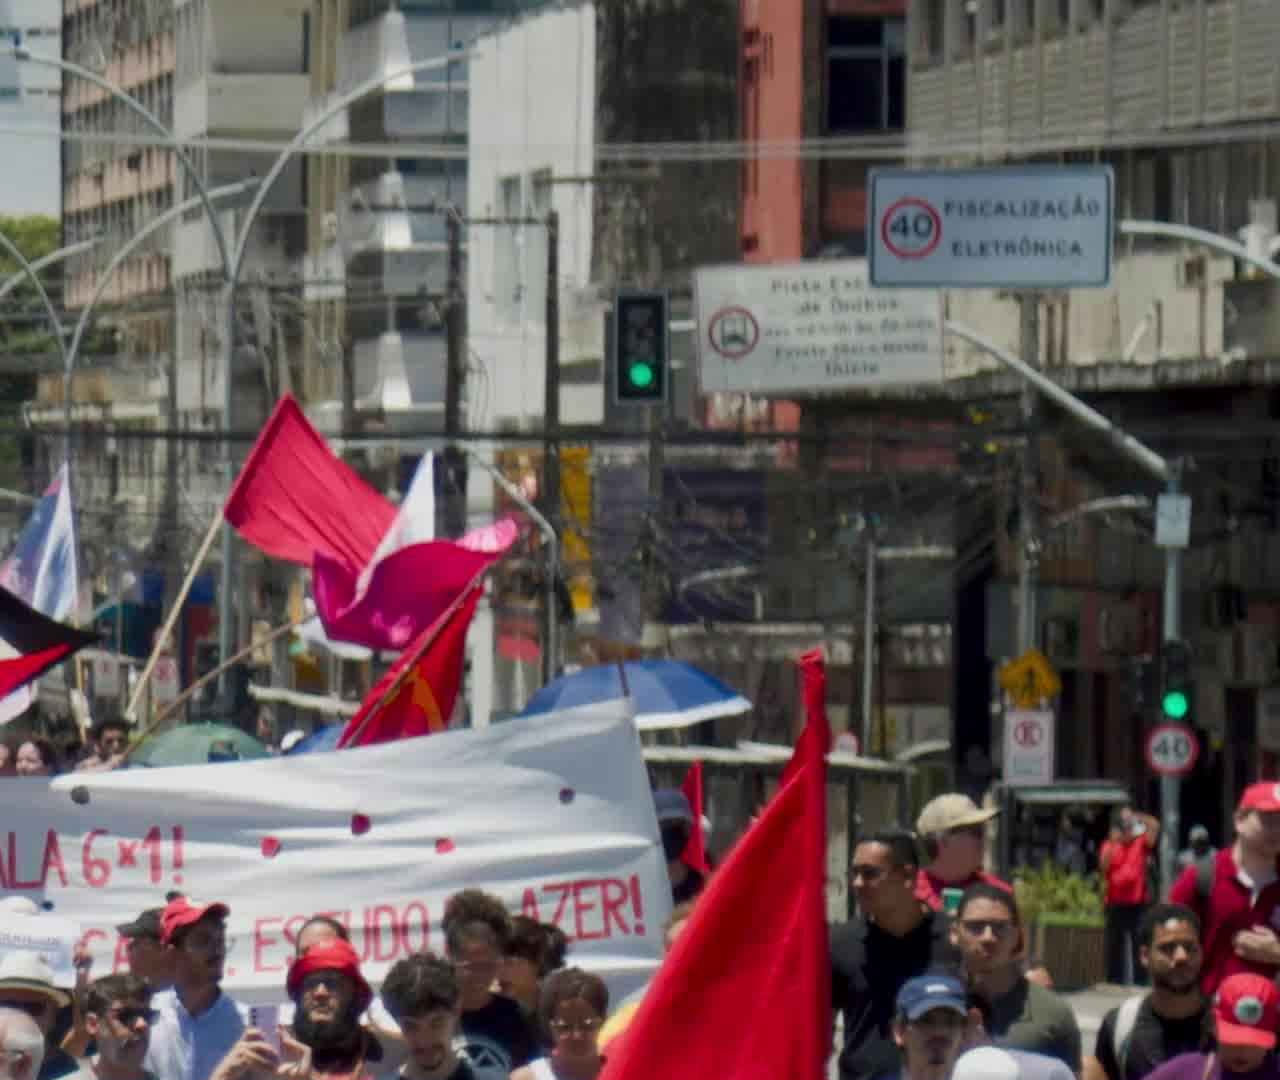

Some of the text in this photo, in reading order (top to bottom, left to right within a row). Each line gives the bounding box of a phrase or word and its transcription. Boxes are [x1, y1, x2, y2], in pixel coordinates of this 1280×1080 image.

[943, 196, 1100, 220] FISCALIZAÇÃO
[889, 214, 934, 238] 40
[950, 236, 1085, 257] ELETRÔNICA
[1153, 736, 1190, 759] 40
